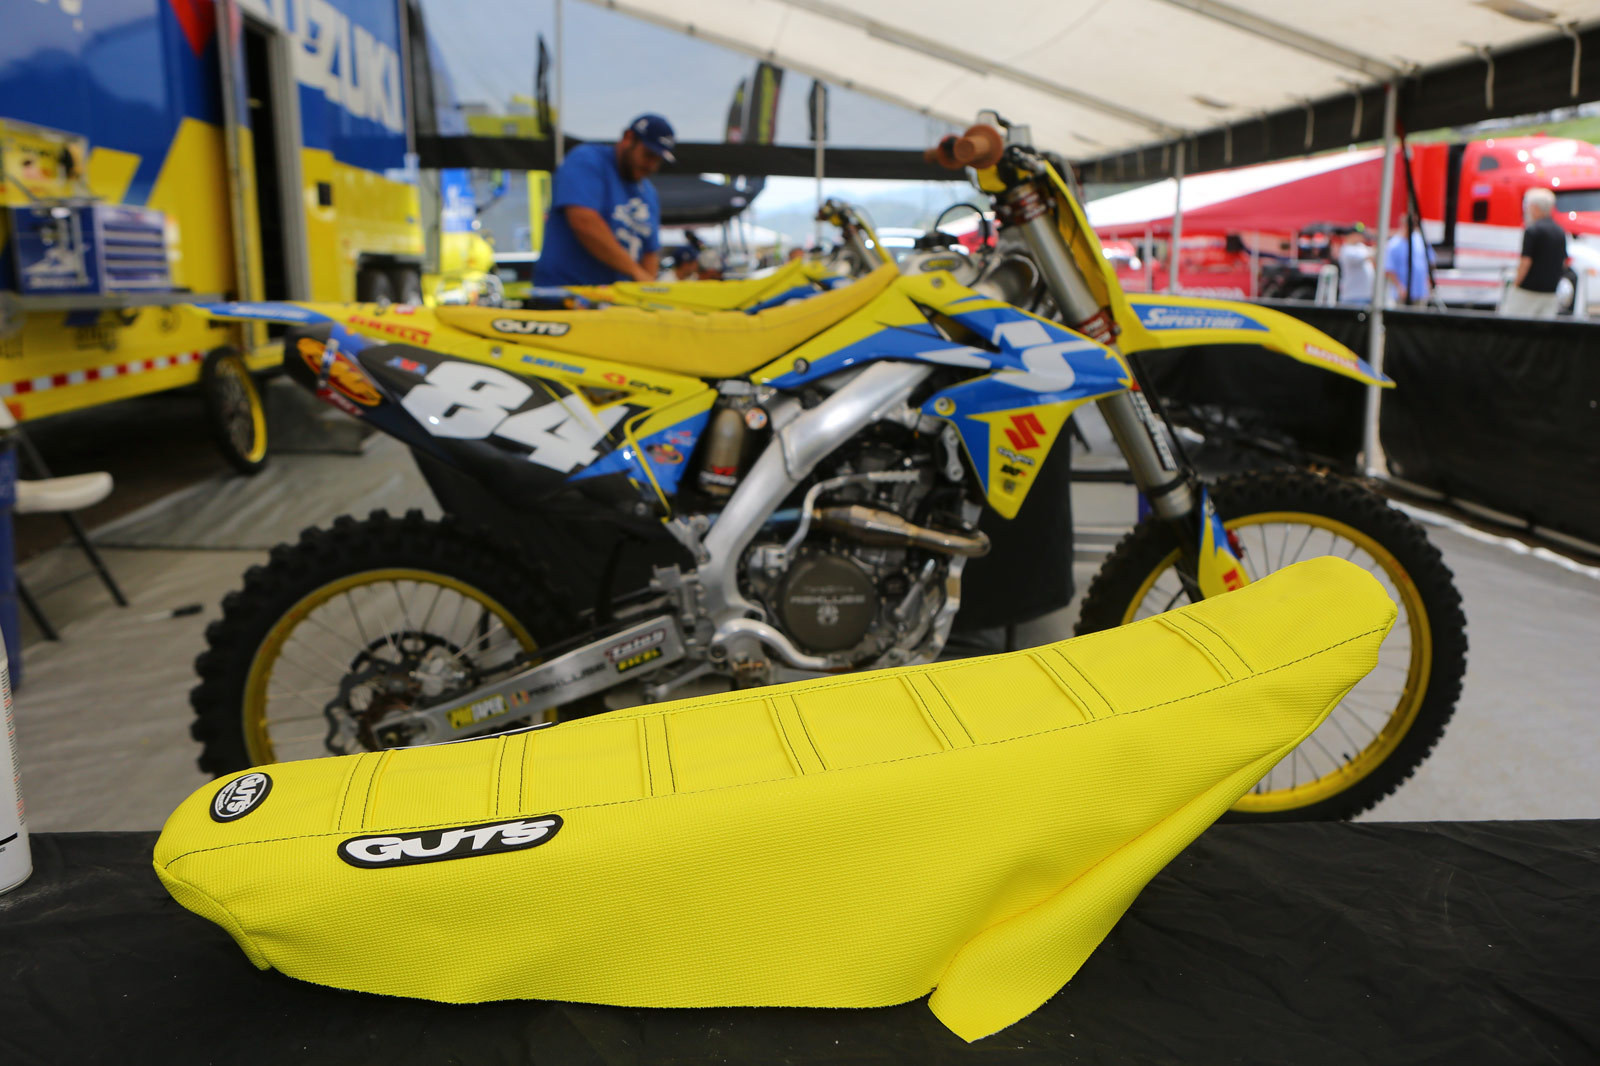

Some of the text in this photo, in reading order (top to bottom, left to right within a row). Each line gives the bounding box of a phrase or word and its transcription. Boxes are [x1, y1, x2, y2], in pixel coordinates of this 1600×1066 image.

[348, 316, 432, 344] PIRELLI
[493, 319, 569, 336] GUTS
[400, 361, 630, 474] 84
[226, 773, 265, 812] GUTS
[345, 819, 556, 862] GUTS
